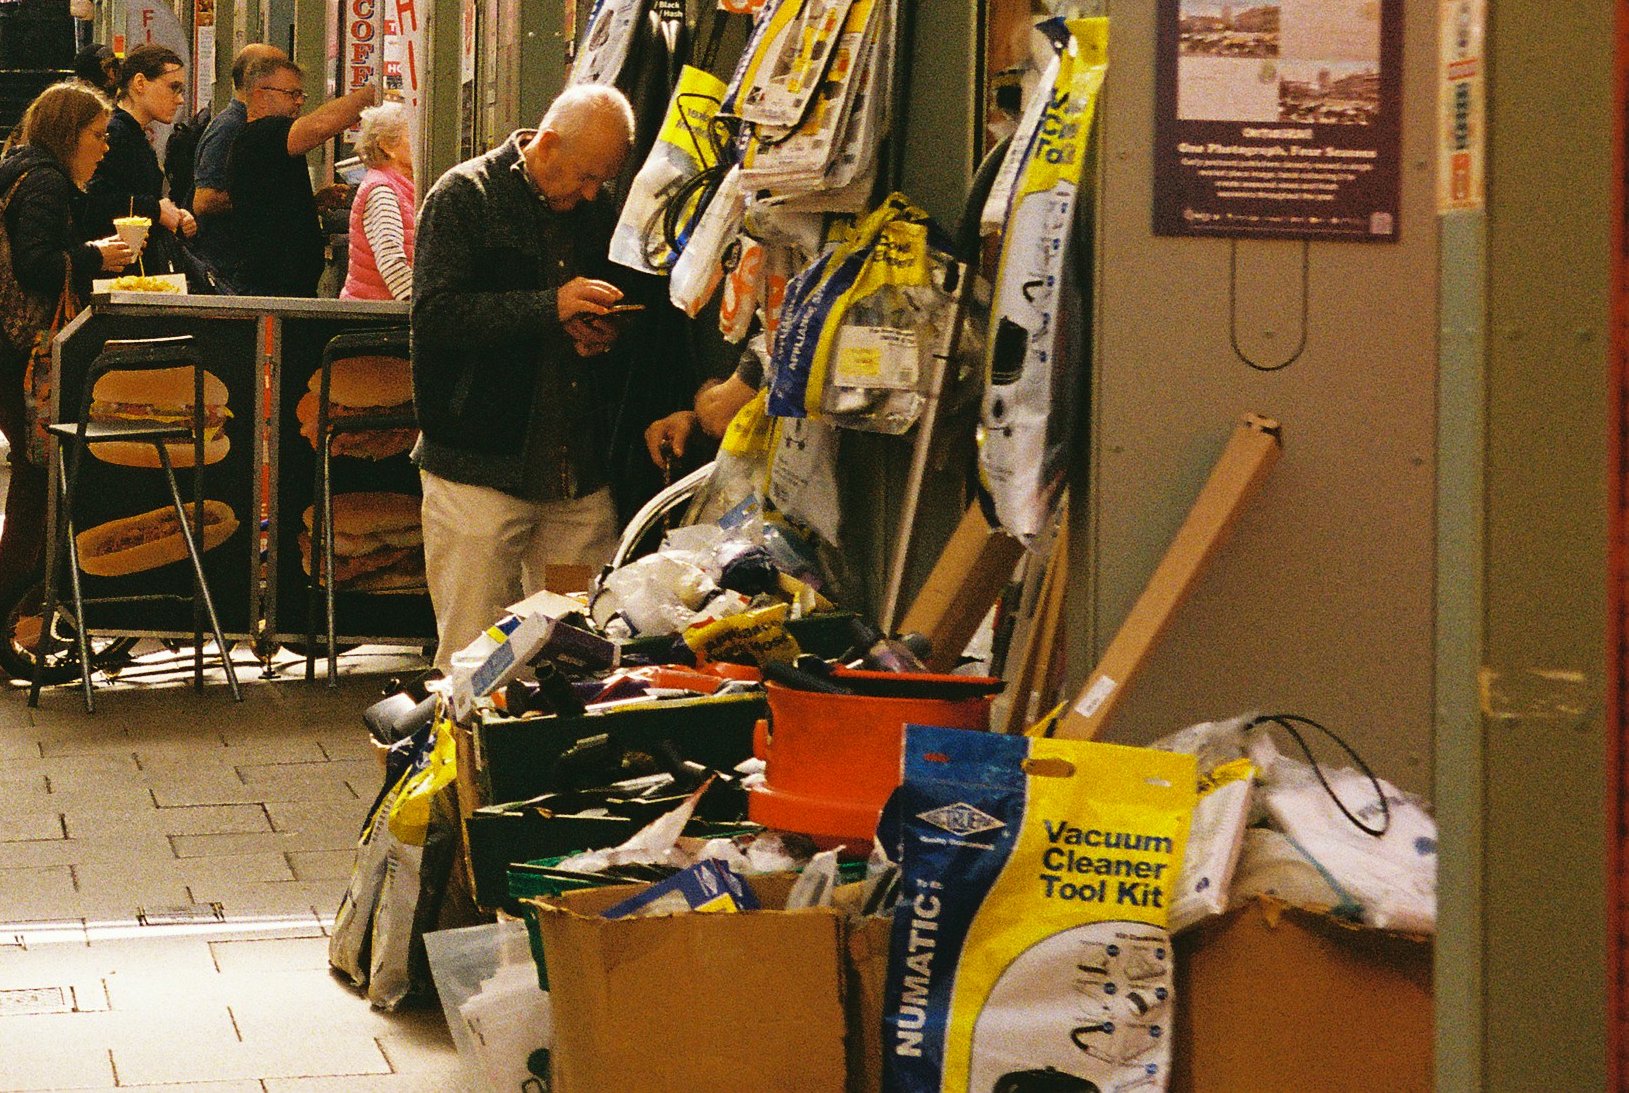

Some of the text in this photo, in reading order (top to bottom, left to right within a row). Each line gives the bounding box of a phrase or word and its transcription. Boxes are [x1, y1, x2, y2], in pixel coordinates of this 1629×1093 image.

[1044, 820, 1172, 855] Vacuum
[1043, 848, 1167, 880] Cleaner
[1040, 875, 1163, 908] Tool Kit
